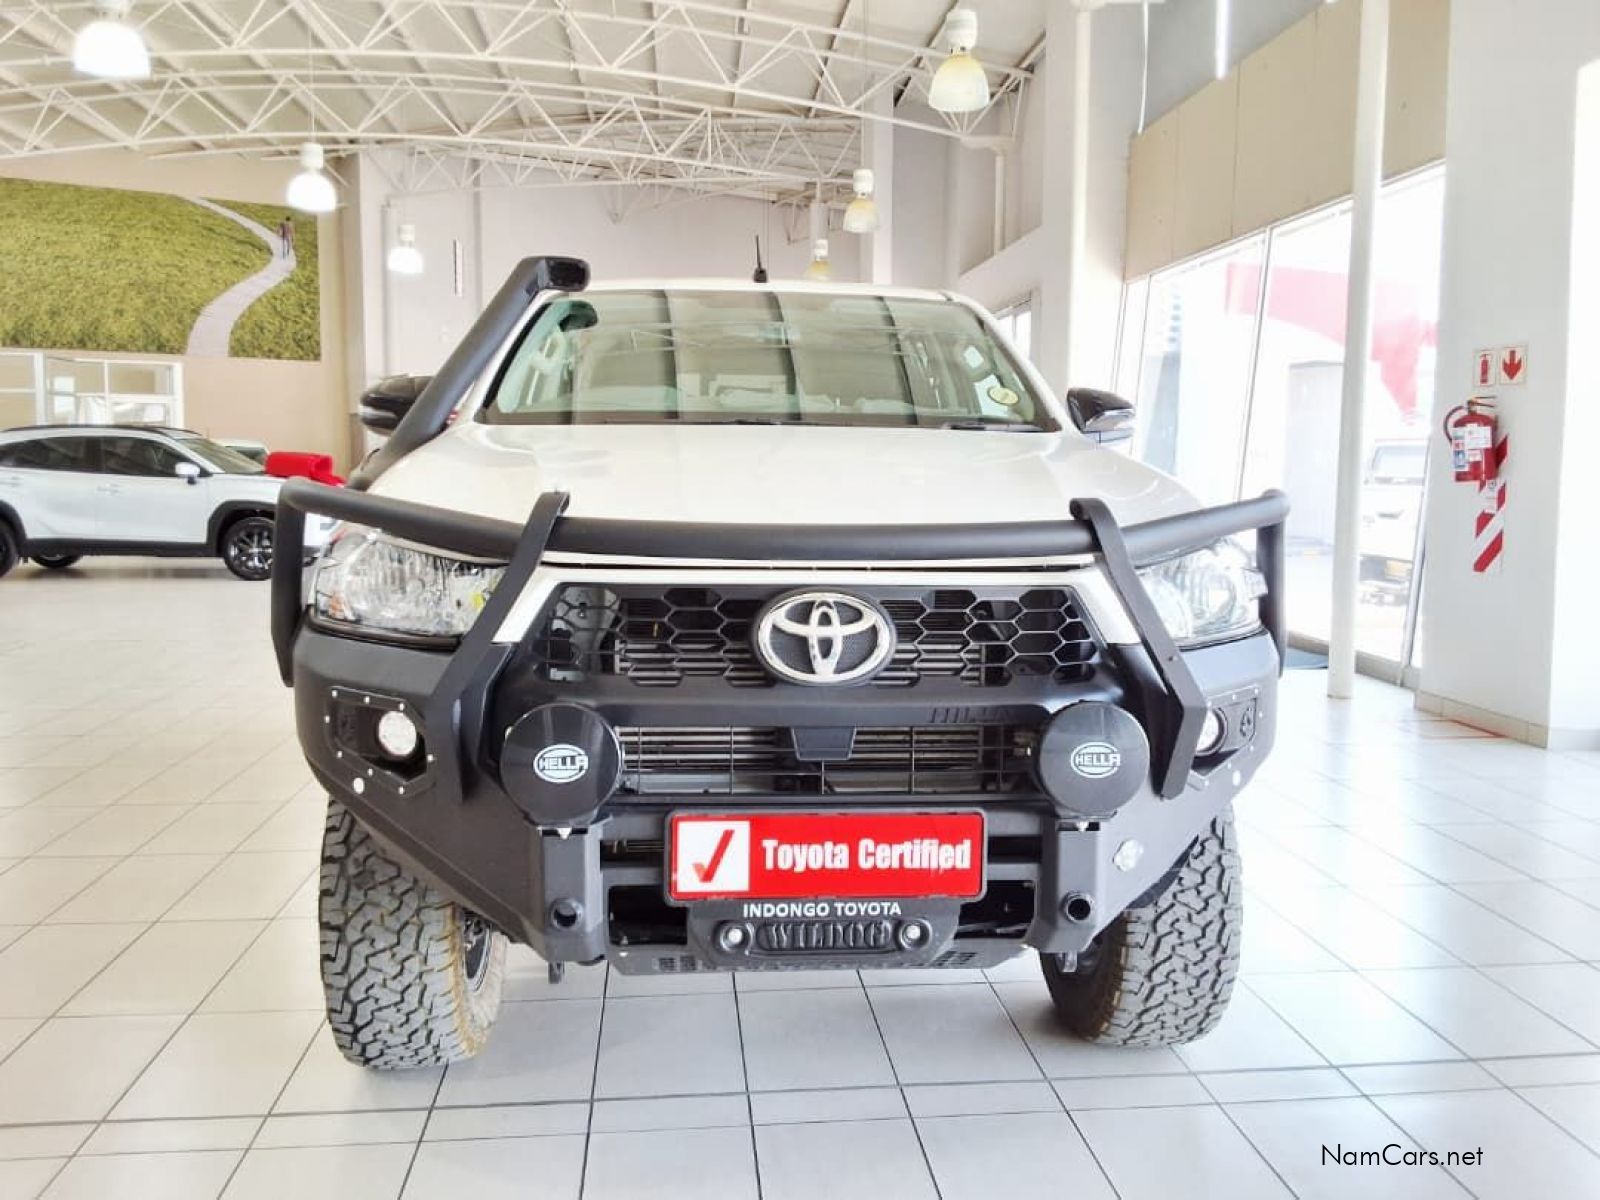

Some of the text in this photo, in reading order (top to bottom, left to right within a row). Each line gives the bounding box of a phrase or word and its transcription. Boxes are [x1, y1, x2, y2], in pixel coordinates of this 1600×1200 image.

[538, 754, 588, 770] HELLA
[1074, 752, 1120, 767] HELLA
[762, 838, 971, 873] Toyota Certified
[743, 902, 902, 918] INDONGO TOYOTA
